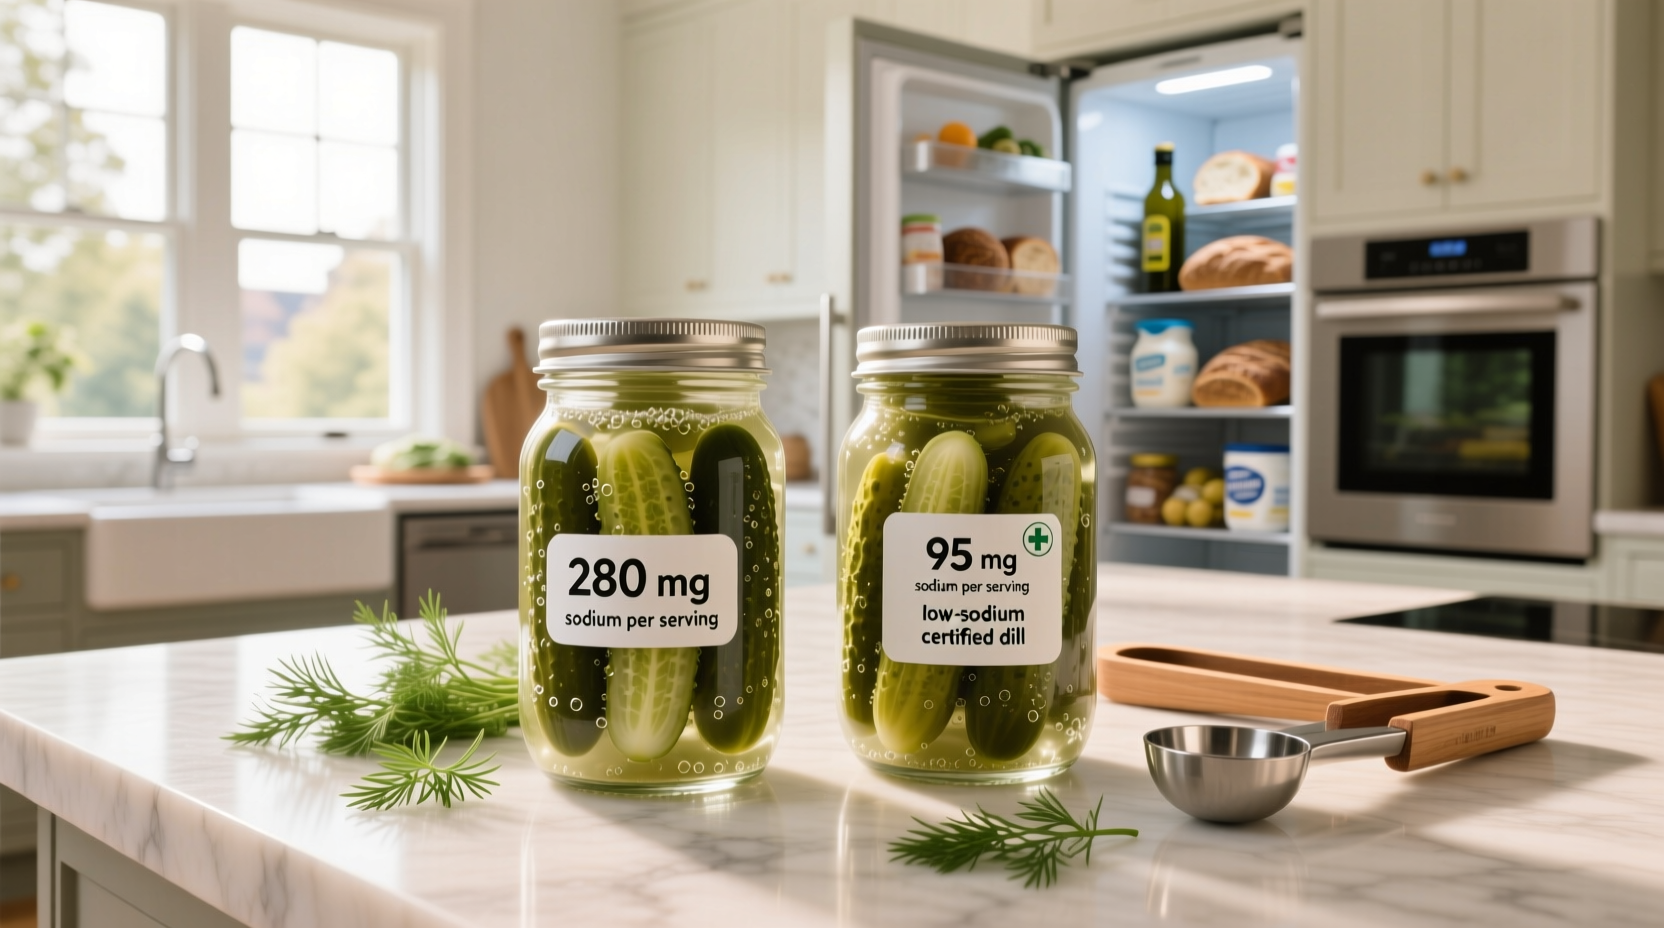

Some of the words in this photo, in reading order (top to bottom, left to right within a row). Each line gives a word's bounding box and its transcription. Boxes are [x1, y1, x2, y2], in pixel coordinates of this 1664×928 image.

[926, 536, 973, 571] 95
[980, 553, 1017, 576] mg
[568, 557, 647, 598] 280
[657, 574, 710, 605] mg
[961, 583, 983, 596] per
[986, 580, 1030, 595] serving
[565, 609, 622, 627] sodium
[626, 615, 655, 632] per
[659, 610, 719, 630] serving
[922, 604, 1025, 622] low-sodium
[921, 627, 994, 645] certified
[999, 627, 1025, 645] dill
